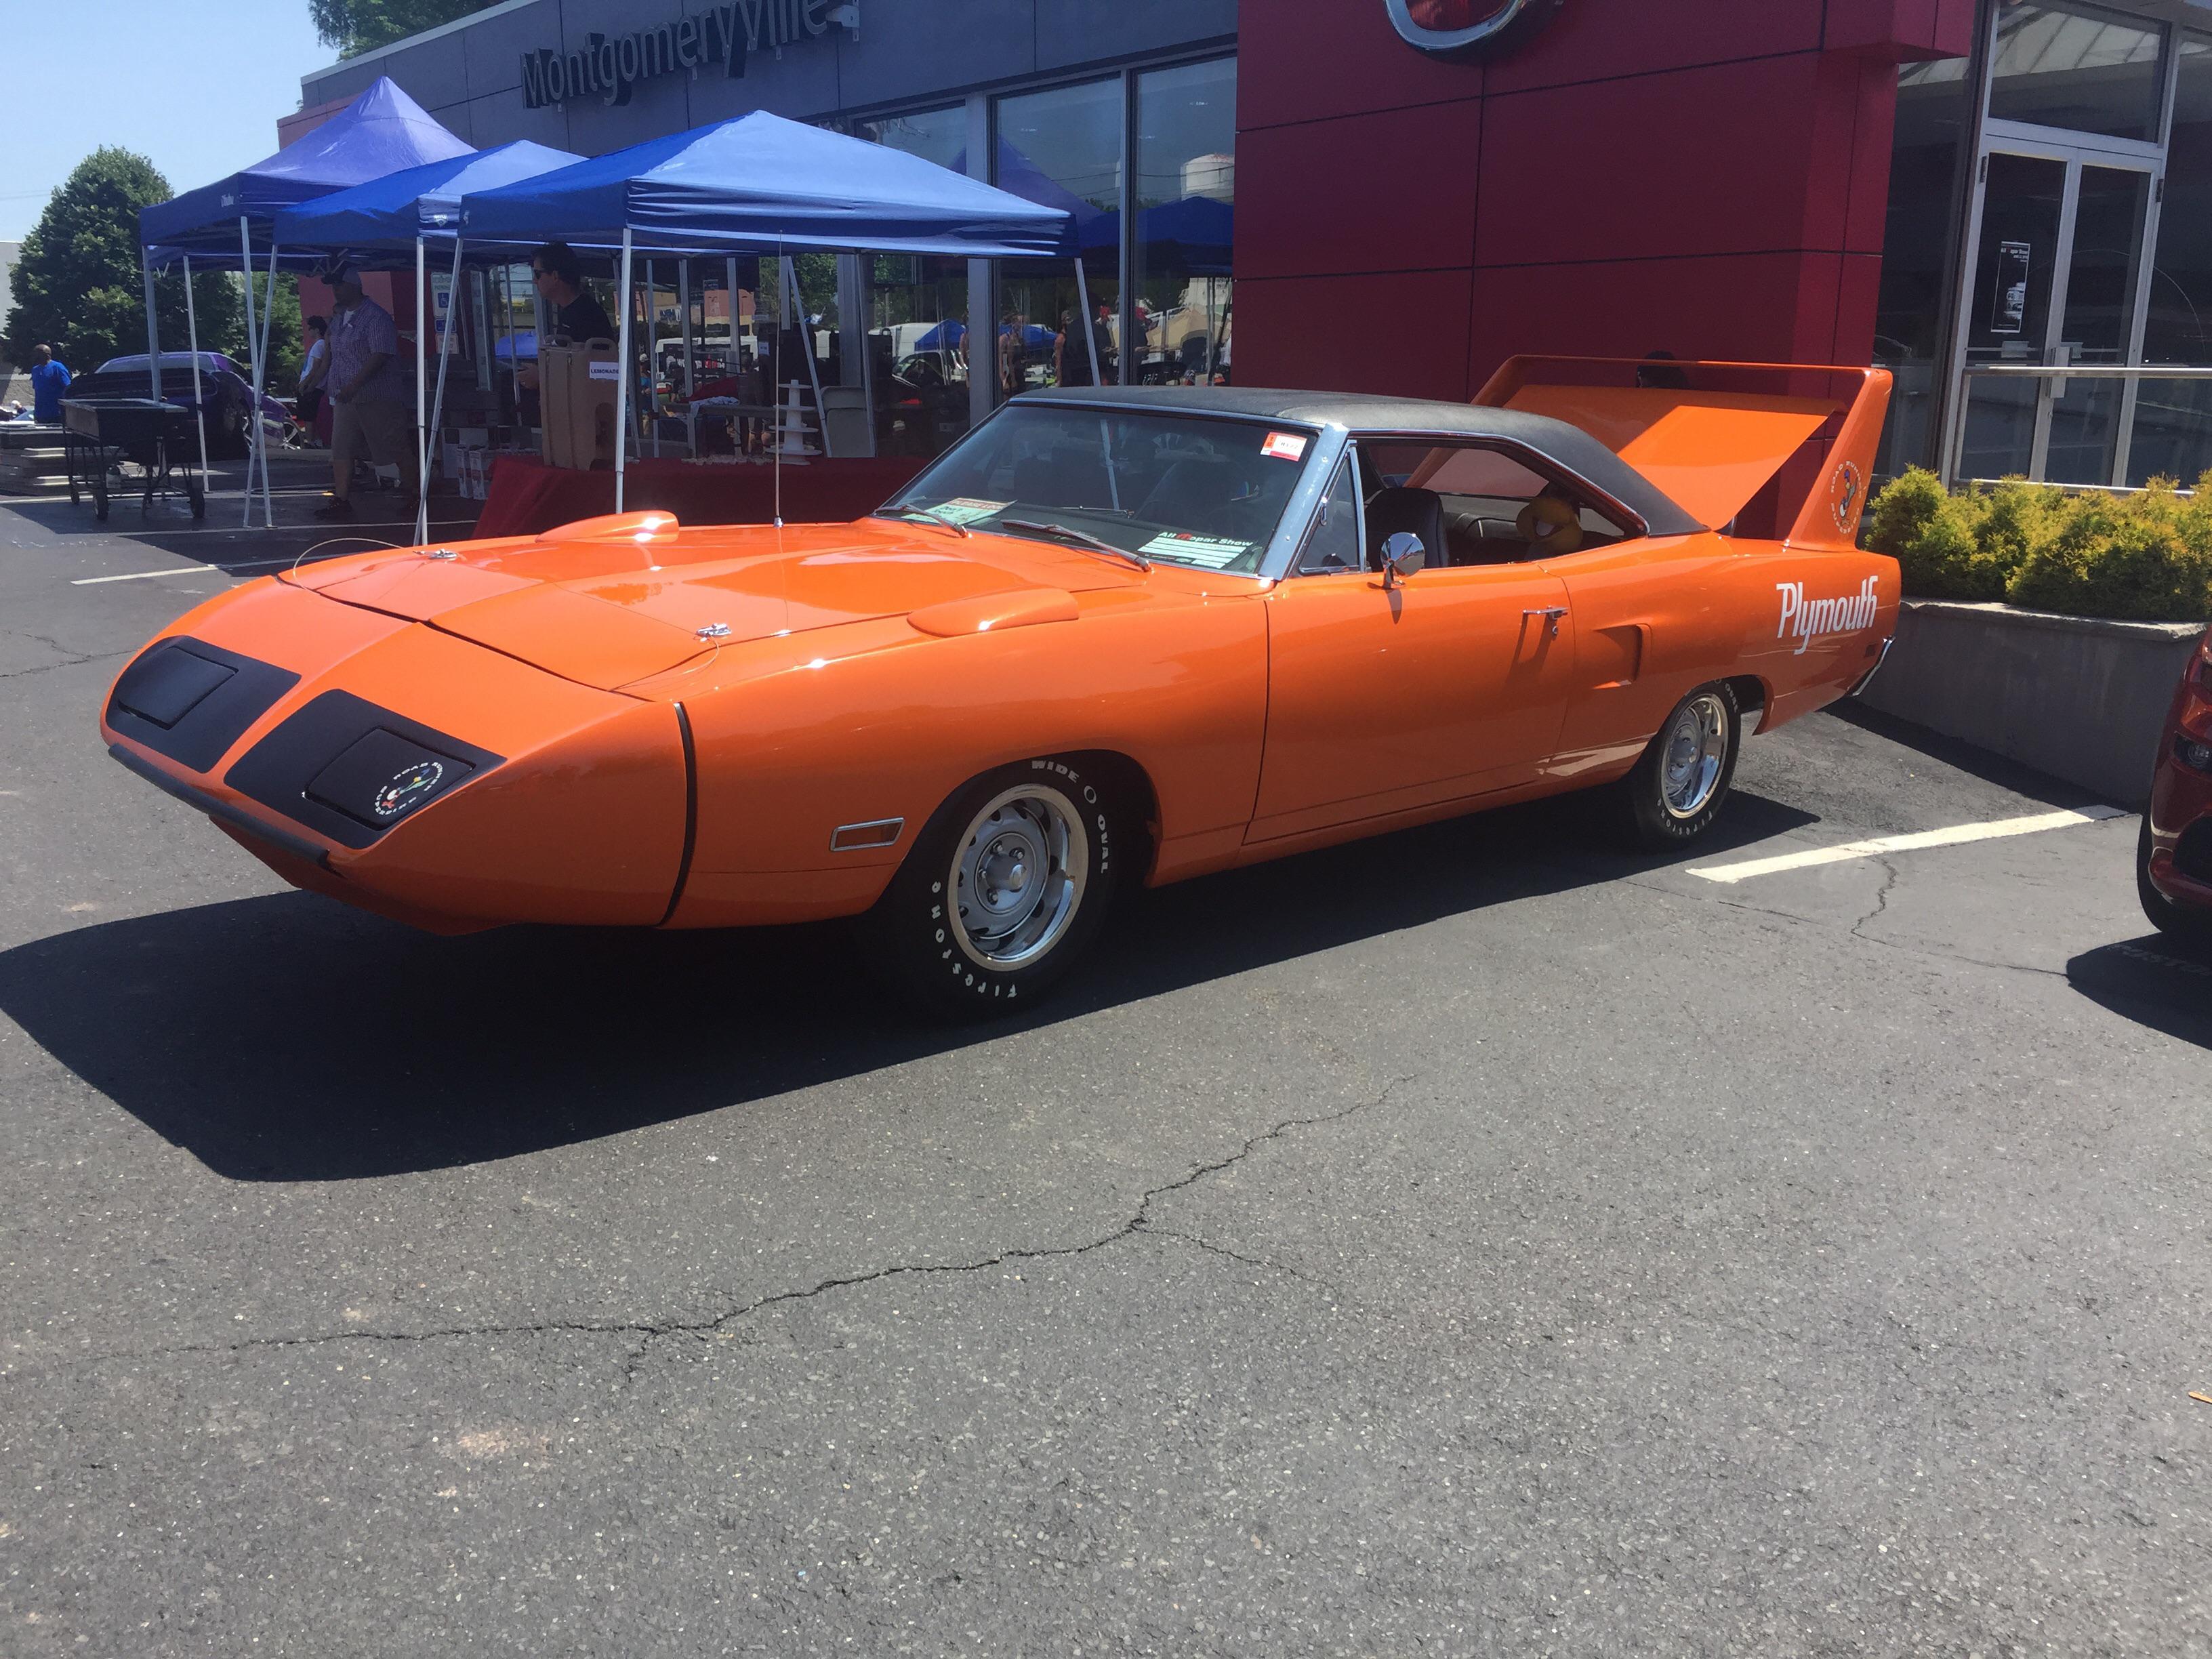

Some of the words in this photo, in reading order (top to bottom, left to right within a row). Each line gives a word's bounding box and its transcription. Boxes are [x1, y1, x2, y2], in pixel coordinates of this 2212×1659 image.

[1176, 533, 1218, 544] Mopar
[1218, 538, 1254, 547] Show
[1776, 575, 1879, 655] Plymouth
[393, 762, 428, 780] ROAD
[1031, 760, 1079, 783] WIDE
[1097, 814, 1109, 874] OVAL
